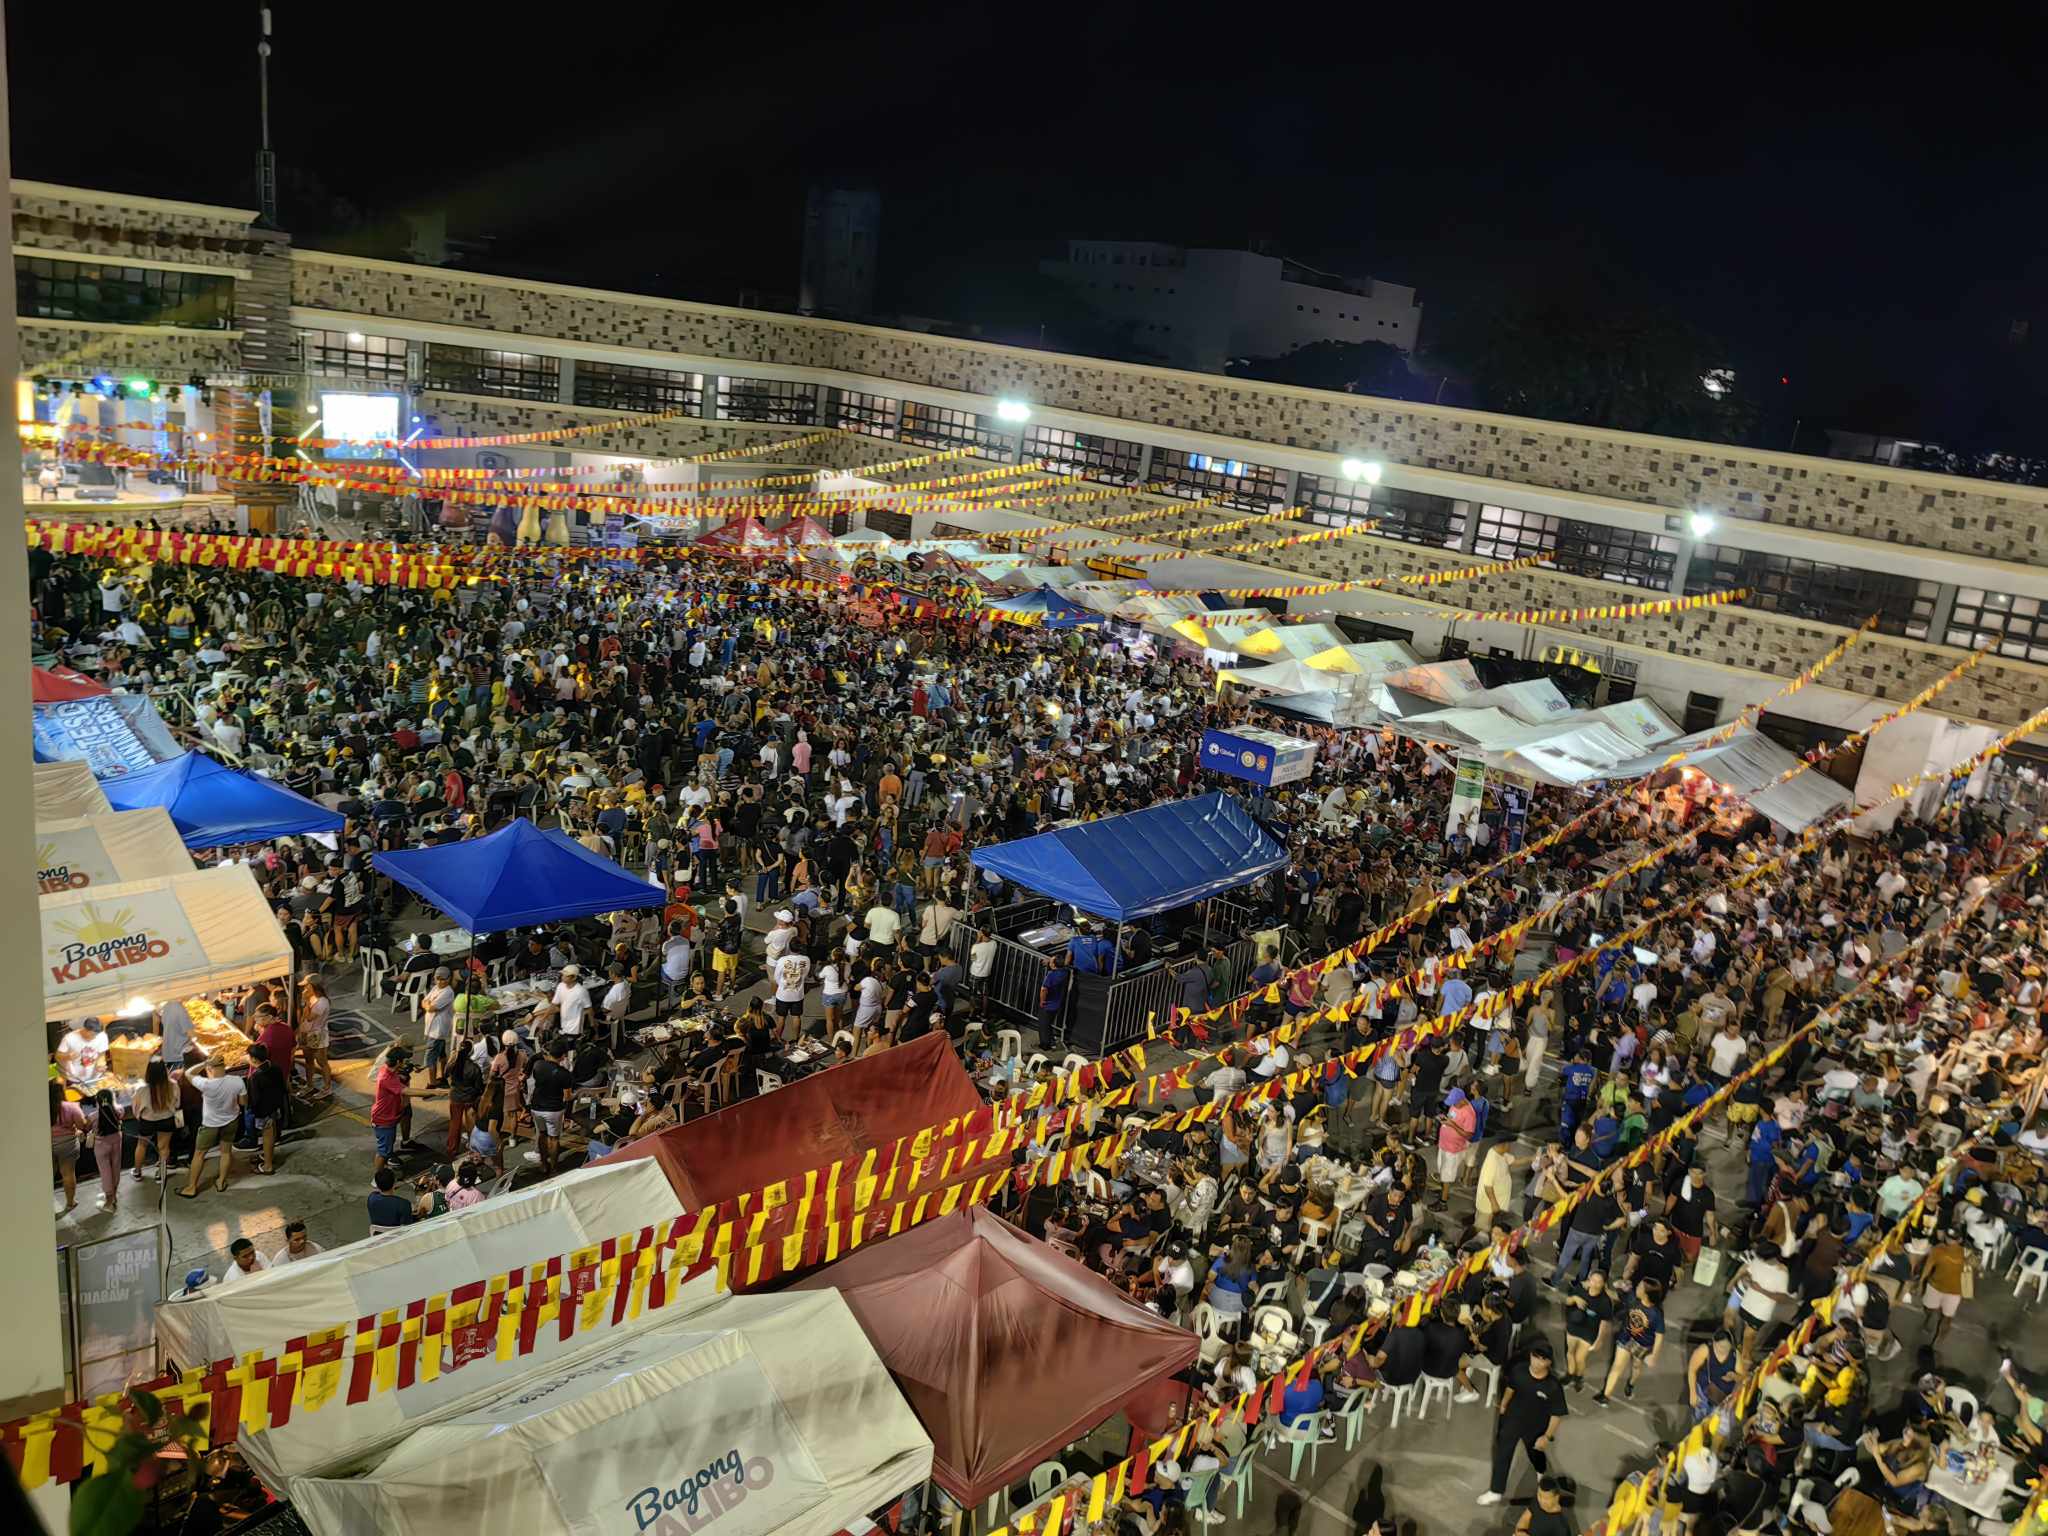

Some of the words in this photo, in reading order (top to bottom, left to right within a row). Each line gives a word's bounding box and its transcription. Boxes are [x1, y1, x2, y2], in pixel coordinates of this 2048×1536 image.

[37, 866, 68, 883] ong
[38, 872, 91, 895] IBO
[51, 939, 170, 984] KALIBO
[60, 932, 148, 964] Bagong
[625, 1449, 744, 1531] Bagong
[634, 1456, 774, 1536] ALIBO
